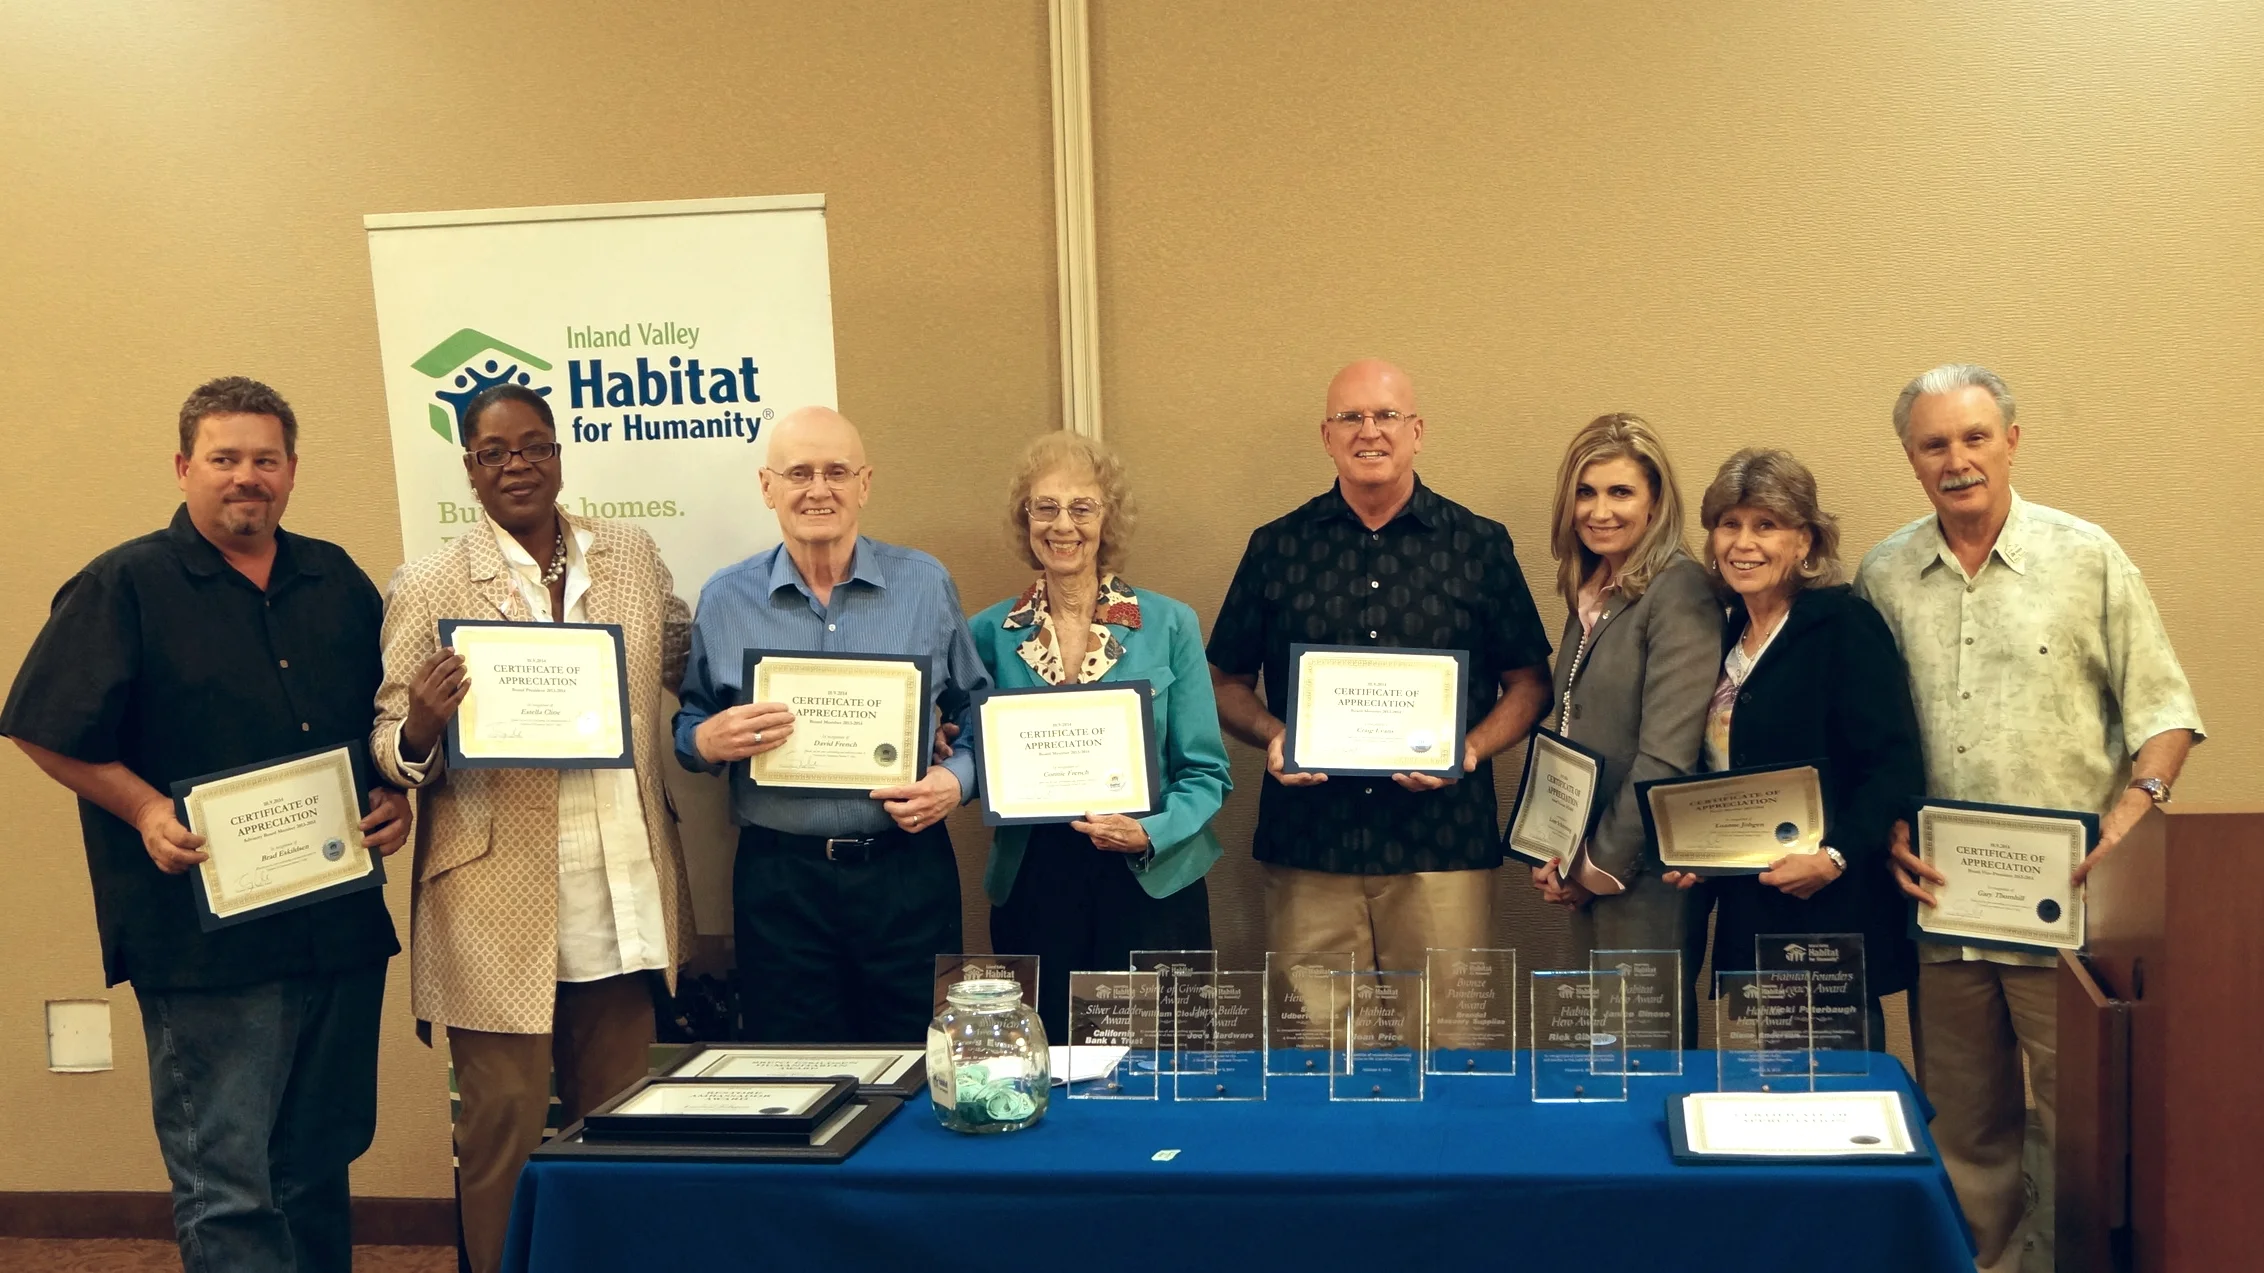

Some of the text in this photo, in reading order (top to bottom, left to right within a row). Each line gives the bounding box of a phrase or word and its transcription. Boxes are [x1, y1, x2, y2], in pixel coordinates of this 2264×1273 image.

[567, 322, 700, 350] Inland Valley
[567, 356, 761, 409] Habitat
[572, 416, 611, 443] for
[579, 496, 687, 520] homes.
[493, 664, 581, 675] CERTIFICATE OF
[498, 676, 578, 687] APPRECIATION
[1334, 687, 1420, 698] CERTIFICATE OF
[792, 696, 882, 708] CERTIFICATE OF
[1338, 698, 1415, 709] APPRECIATION
[795, 708, 877, 719] APPRECIATION
[1019, 727, 1106, 740] CERTIFICATE OF
[813, 739, 858, 748] David French
[1024, 739, 1102, 751] APPRECIATION
[1689, 793, 1763, 806] CERTIFICATE
[1764, 789, 1781, 797] OF
[1695, 797, 1778, 811] APPRECIATION
[230, 795, 320, 826] CERTIFICATE OF
[237, 807, 319, 837] APPRECIATION
[261, 852, 278, 862] Brad
[1956, 845, 2046, 864] CERTIFICATE OF
[1960, 857, 2042, 875] APPRECIATION
[1977, 889, 1993, 898] Gary
[1808, 948, 1839, 957] Habitat
[985, 969, 1015, 979] Habitat
[1811, 970, 1854, 982] Founders
[1457, 978, 1487, 988] Bronze
[1813, 983, 1847, 993] Award
[1446, 988, 1495, 999] Paintbrush
[1633, 993, 1664, 1004] Award
[1086, 1004, 1142, 1015] Silver Ladder
[1218, 1005, 1249, 1015] Builder
[1456, 1000, 1488, 1010] Award
[1360, 1006, 1396, 1017] Habitat
[1560, 1005, 1597, 1017] Habitat
[1207, 1016, 1238, 1027] Award
[1374, 1016, 1405, 1028] Award
[1551, 1016, 1574, 1027] Hero
[1093, 1029, 1135, 1038] California
[1352, 1033, 1403, 1041] Joan Price
[1548, 1033, 1570, 1041] Rick
[1085, 1036, 1108, 1045] Bank
[1121, 1037, 1143, 1045] Trust
